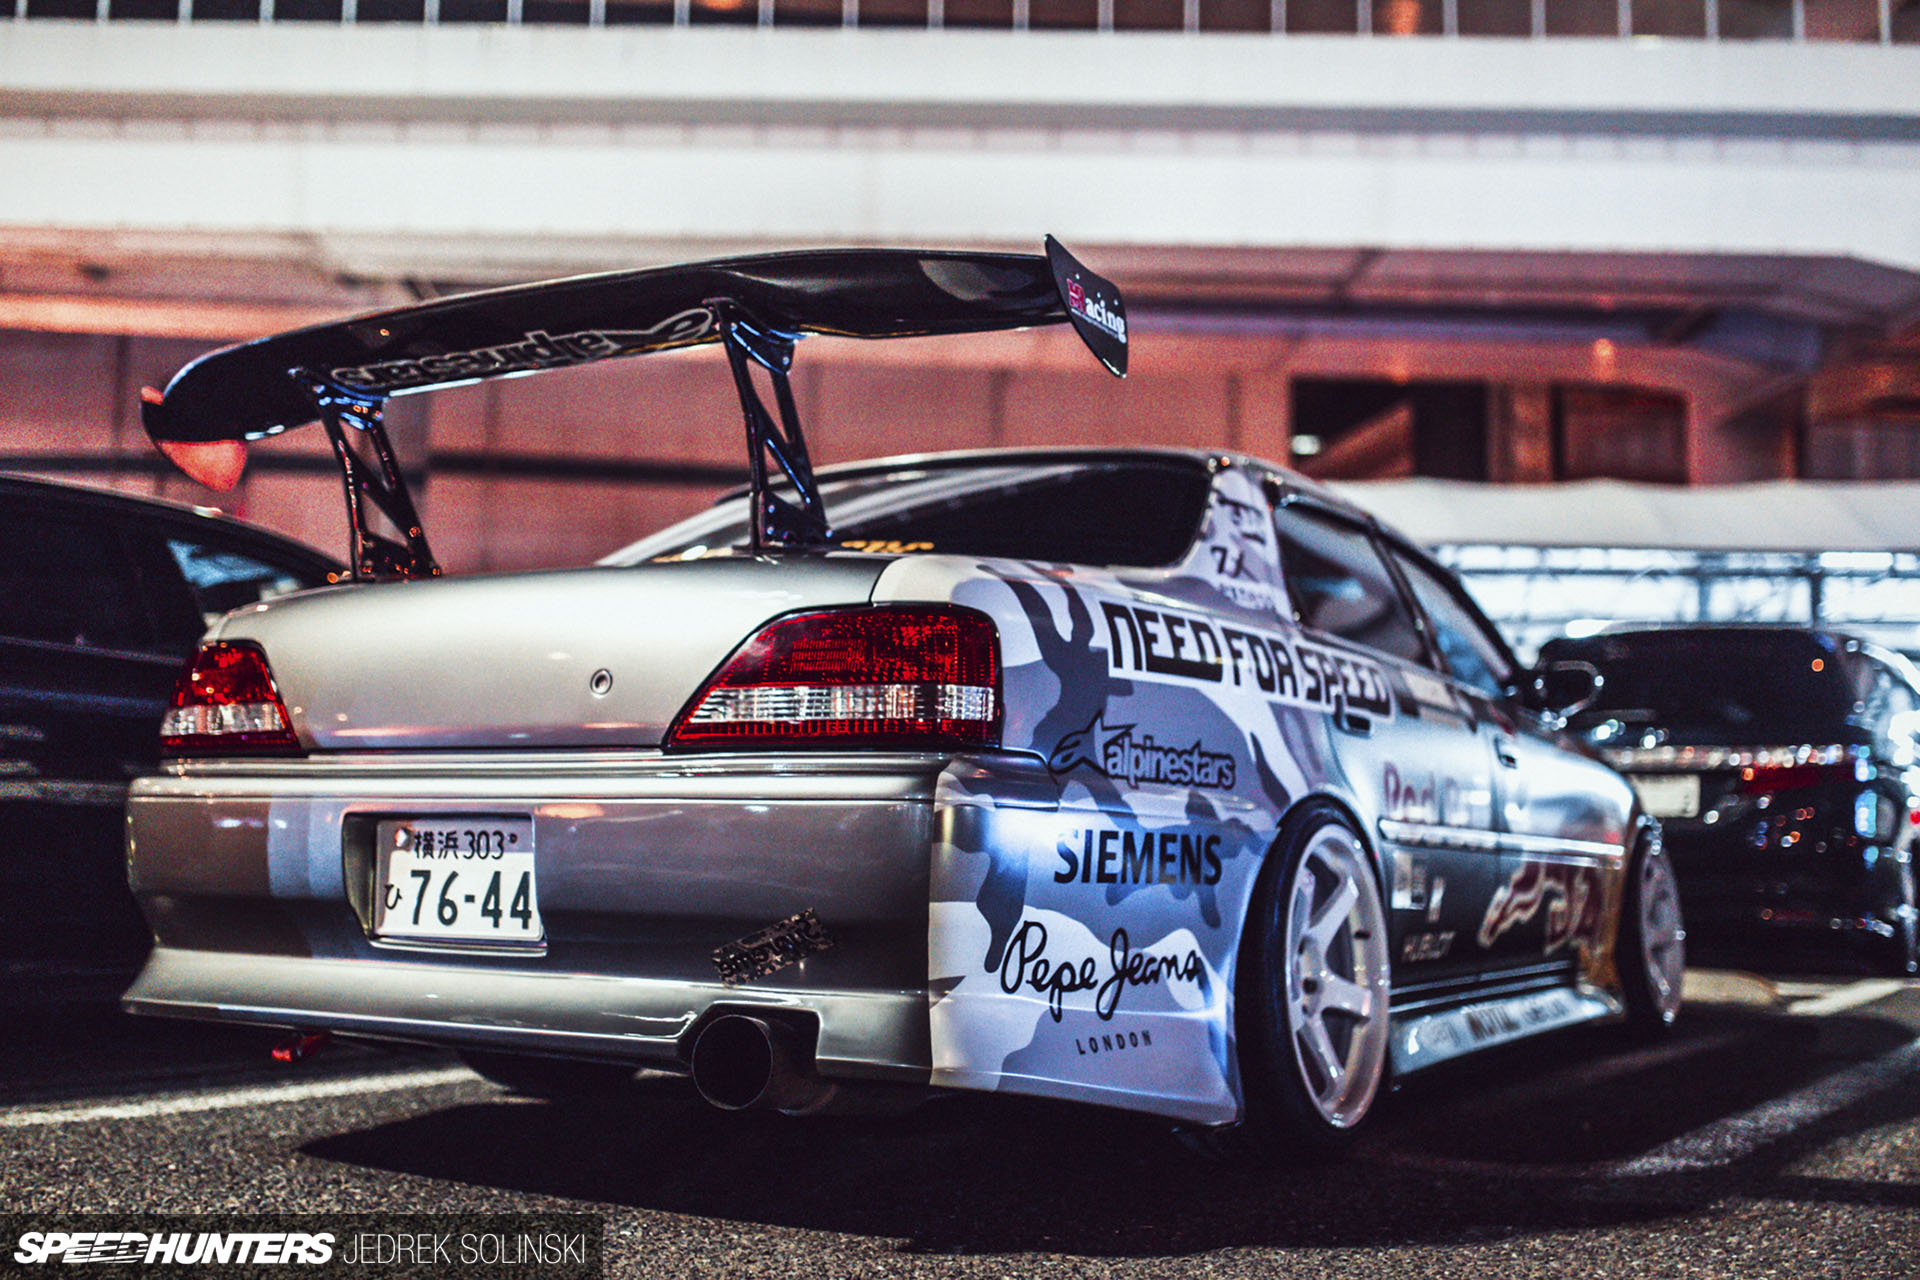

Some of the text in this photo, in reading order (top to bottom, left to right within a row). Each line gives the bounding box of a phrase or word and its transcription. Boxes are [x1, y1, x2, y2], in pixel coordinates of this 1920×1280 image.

[1100, 601, 1391, 716] NEED FOR SPEED
[1103, 732, 1236, 790] alpinestars
[1054, 829, 1222, 886] SIEMENS
[411, 869, 532, 930] 76-44
[1001, 921, 1201, 1023] Pepe Jeans
[1076, 1030, 1153, 1055] LONDON
